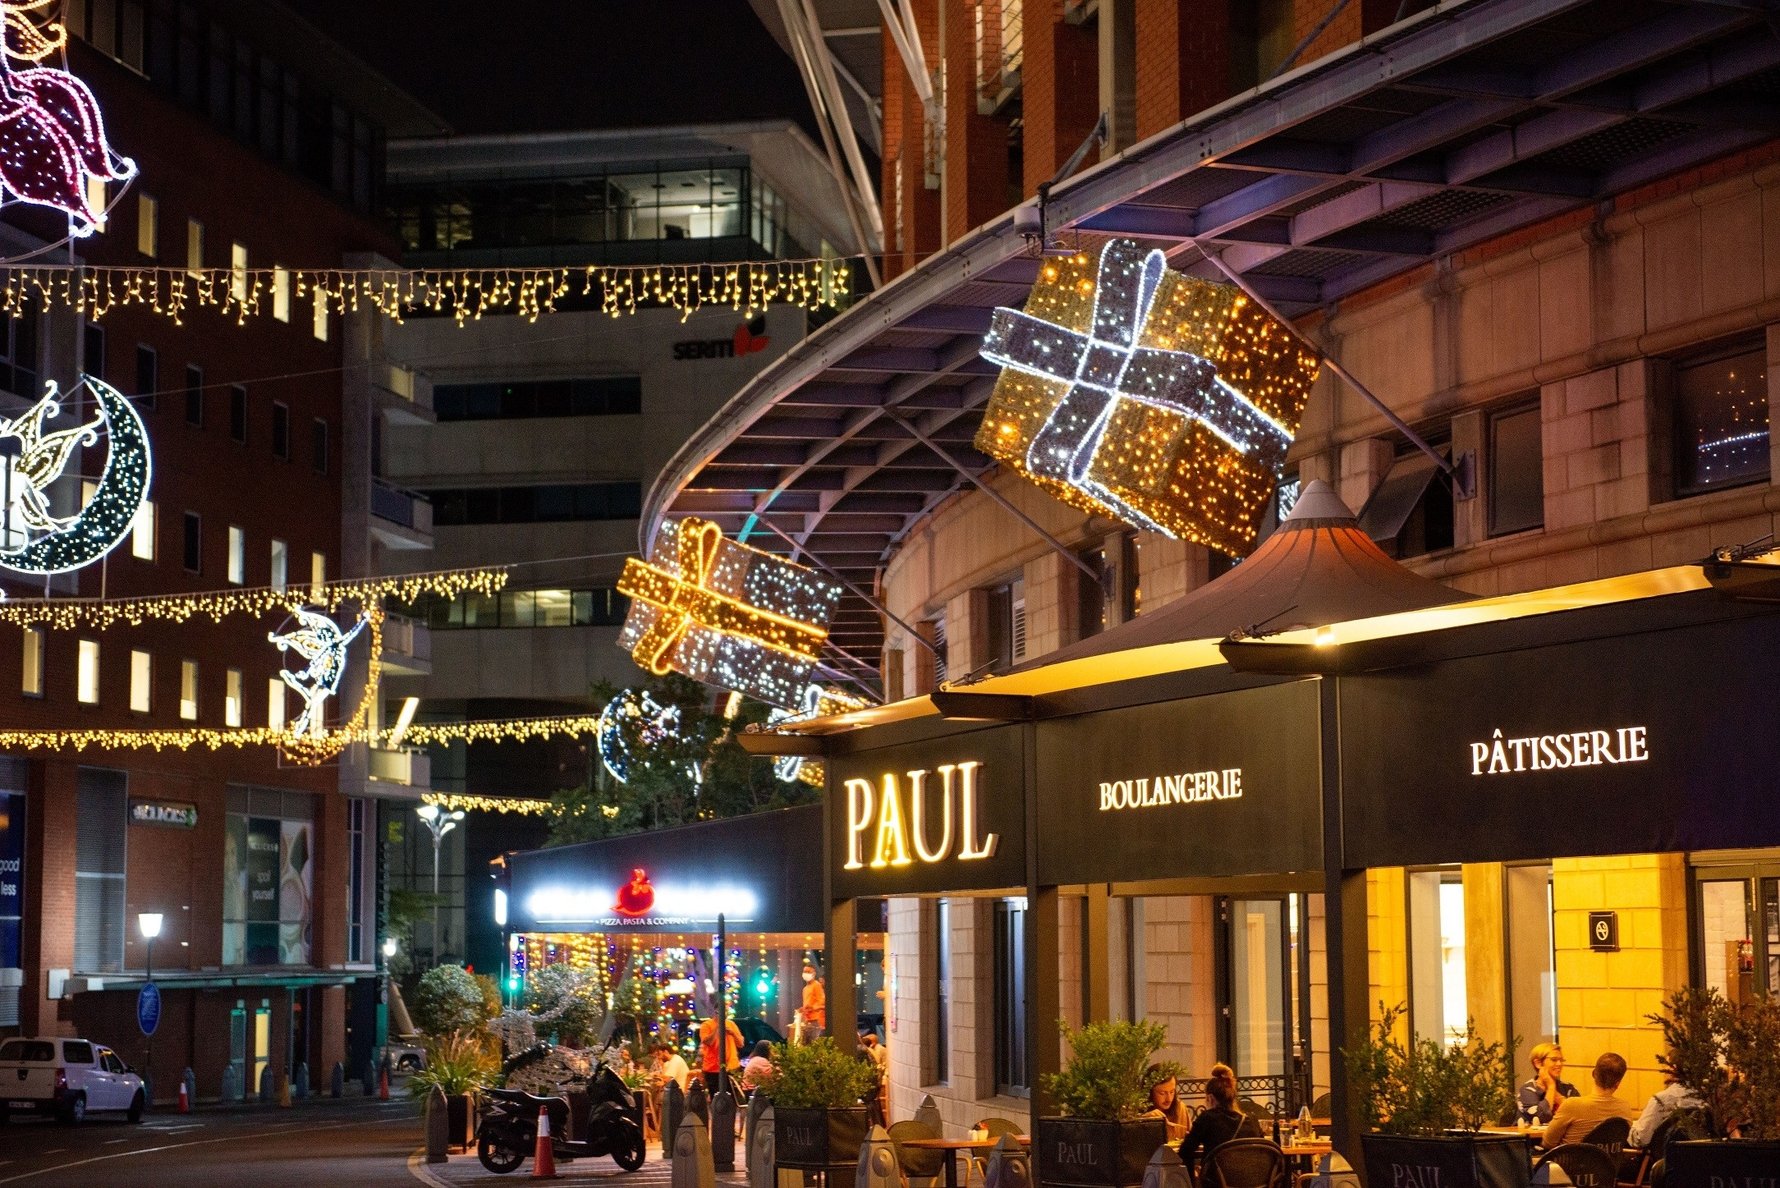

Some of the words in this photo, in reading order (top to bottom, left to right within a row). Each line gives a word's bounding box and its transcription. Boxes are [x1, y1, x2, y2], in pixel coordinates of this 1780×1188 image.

[1470, 727, 1649, 776] PÂTISSERIE
[1099, 768, 1243, 811] BOULANGERIE
[844, 761, 999, 869] PAUL
[1, 881, 17, 896] less
[653, 917, 690, 925] COMPANY
[786, 1126, 813, 1146] PAUL
[1057, 1141, 1098, 1165] PAUL
